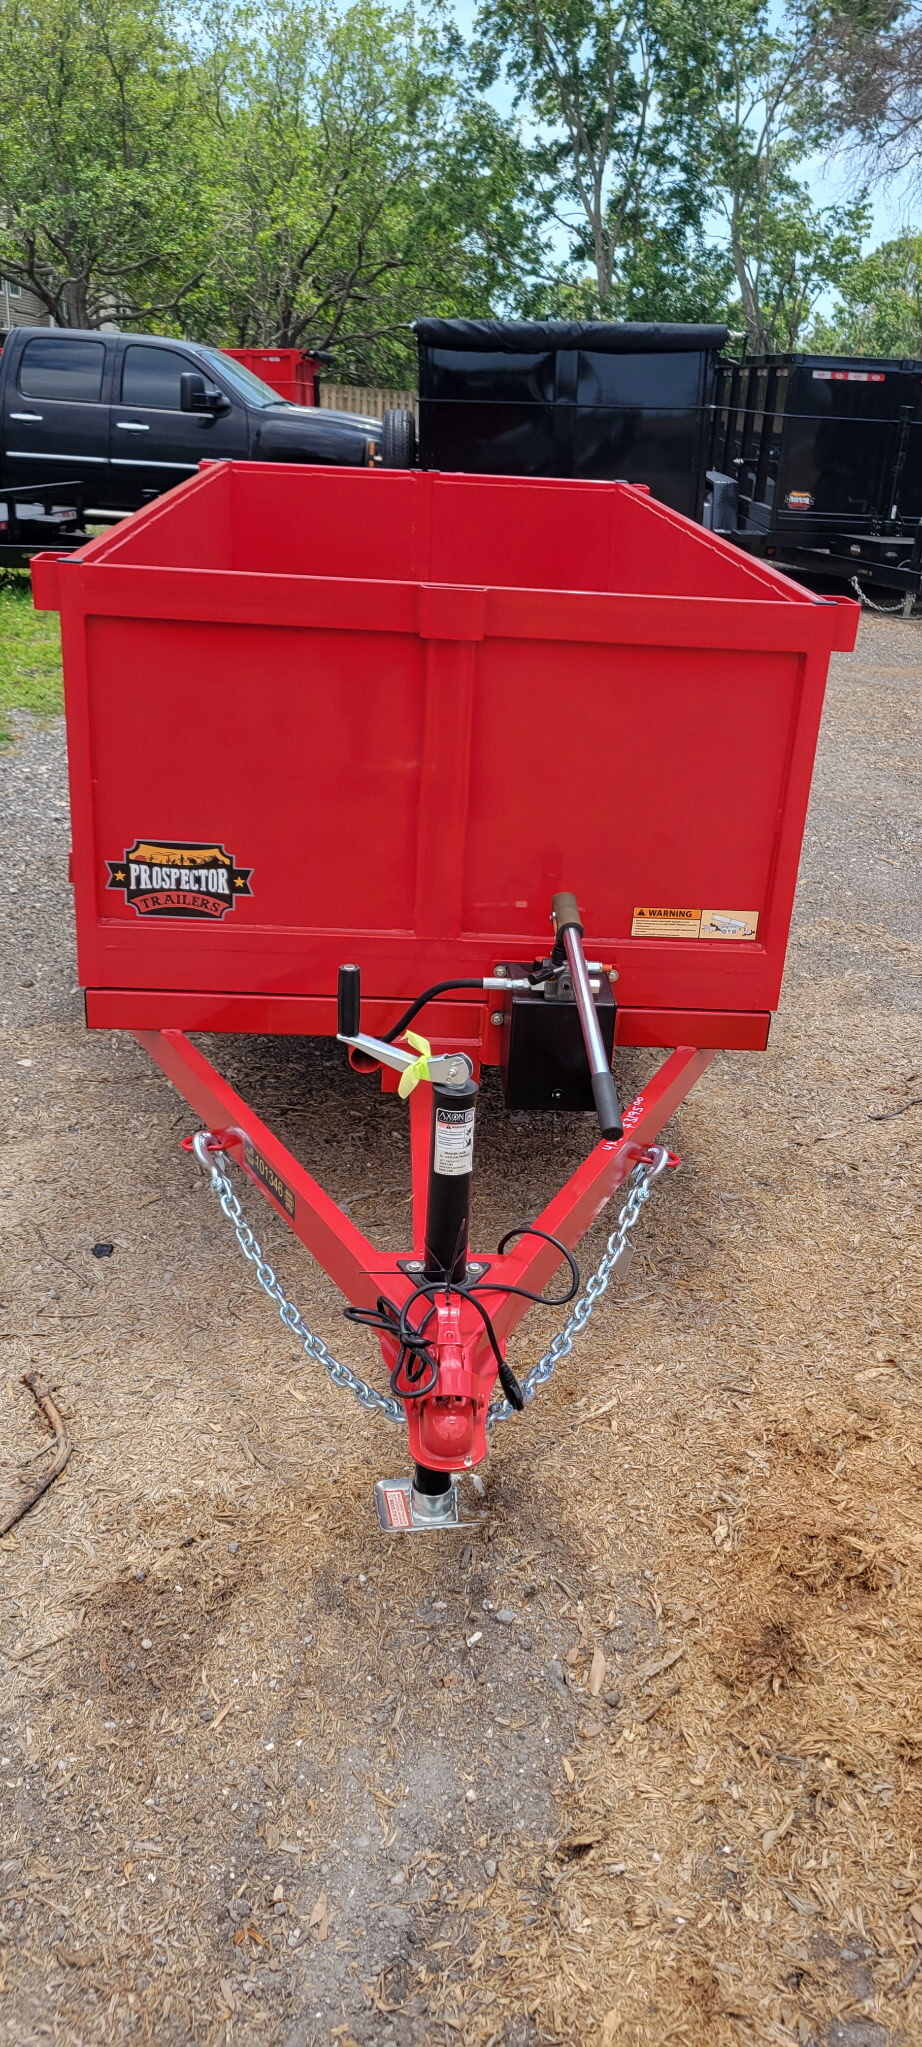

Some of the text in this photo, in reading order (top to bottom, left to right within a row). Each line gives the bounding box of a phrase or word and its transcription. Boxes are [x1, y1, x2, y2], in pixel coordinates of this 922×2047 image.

[129, 863, 230, 894] PROSPECTOR
[140, 894, 220, 913] TRAILERS
[649, 910, 692, 918] WARNING
[439, 1112, 464, 1121] AXON
